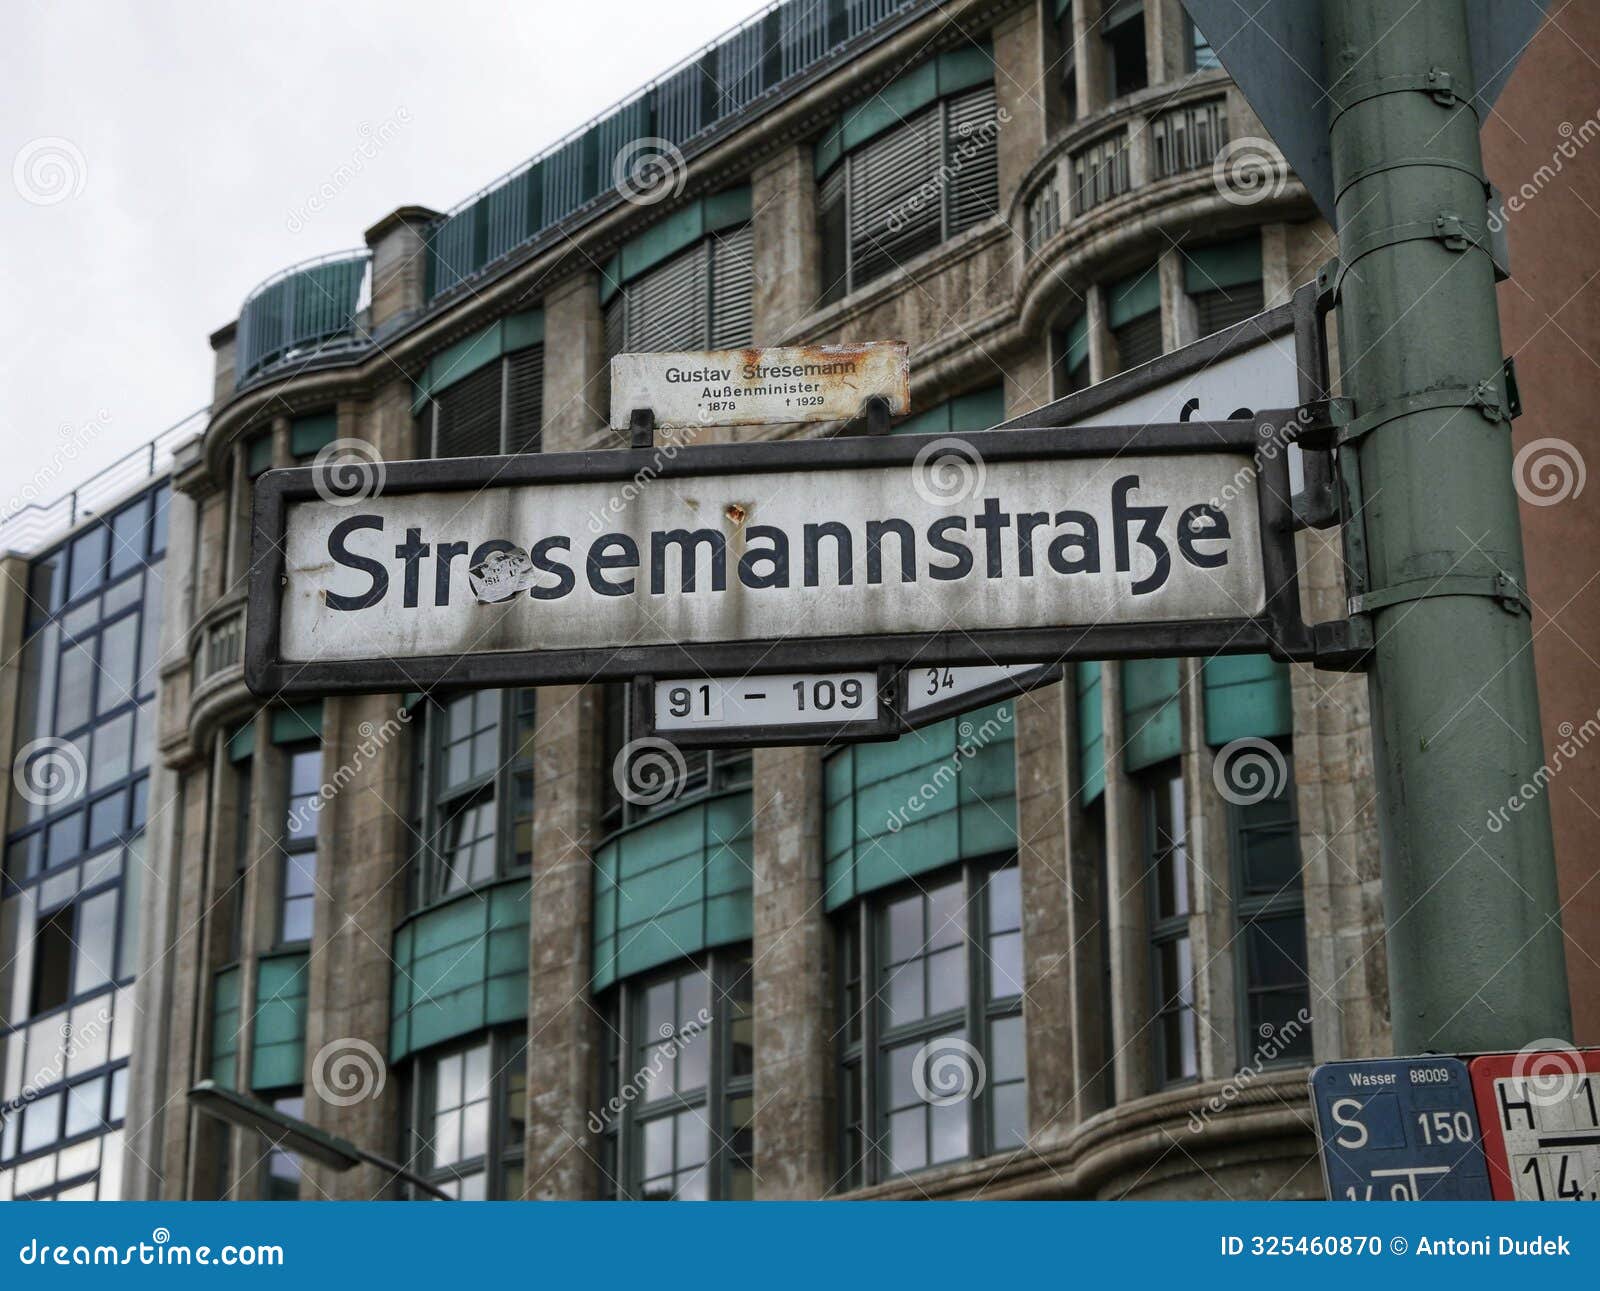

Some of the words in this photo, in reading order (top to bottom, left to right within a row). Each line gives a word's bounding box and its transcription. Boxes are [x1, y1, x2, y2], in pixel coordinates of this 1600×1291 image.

[665, 367, 731, 383] Gustav
[742, 361, 856, 380] Stresemann
[701, 383, 820, 399] Außenminister
[708, 401, 736, 411] 1878
[796, 396, 825, 406] 1929
[926, 667, 955, 695] 34
[668, 685, 712, 718] 91
[791, 679, 863, 711] 109
[1349, 1072, 1397, 1087] Wasser
[1409, 1068, 1449, 1083] 88009
[1498, 1082, 1535, 1130] H
[1331, 1098, 1369, 1149] S
[1418, 1111, 1474, 1146] 150
